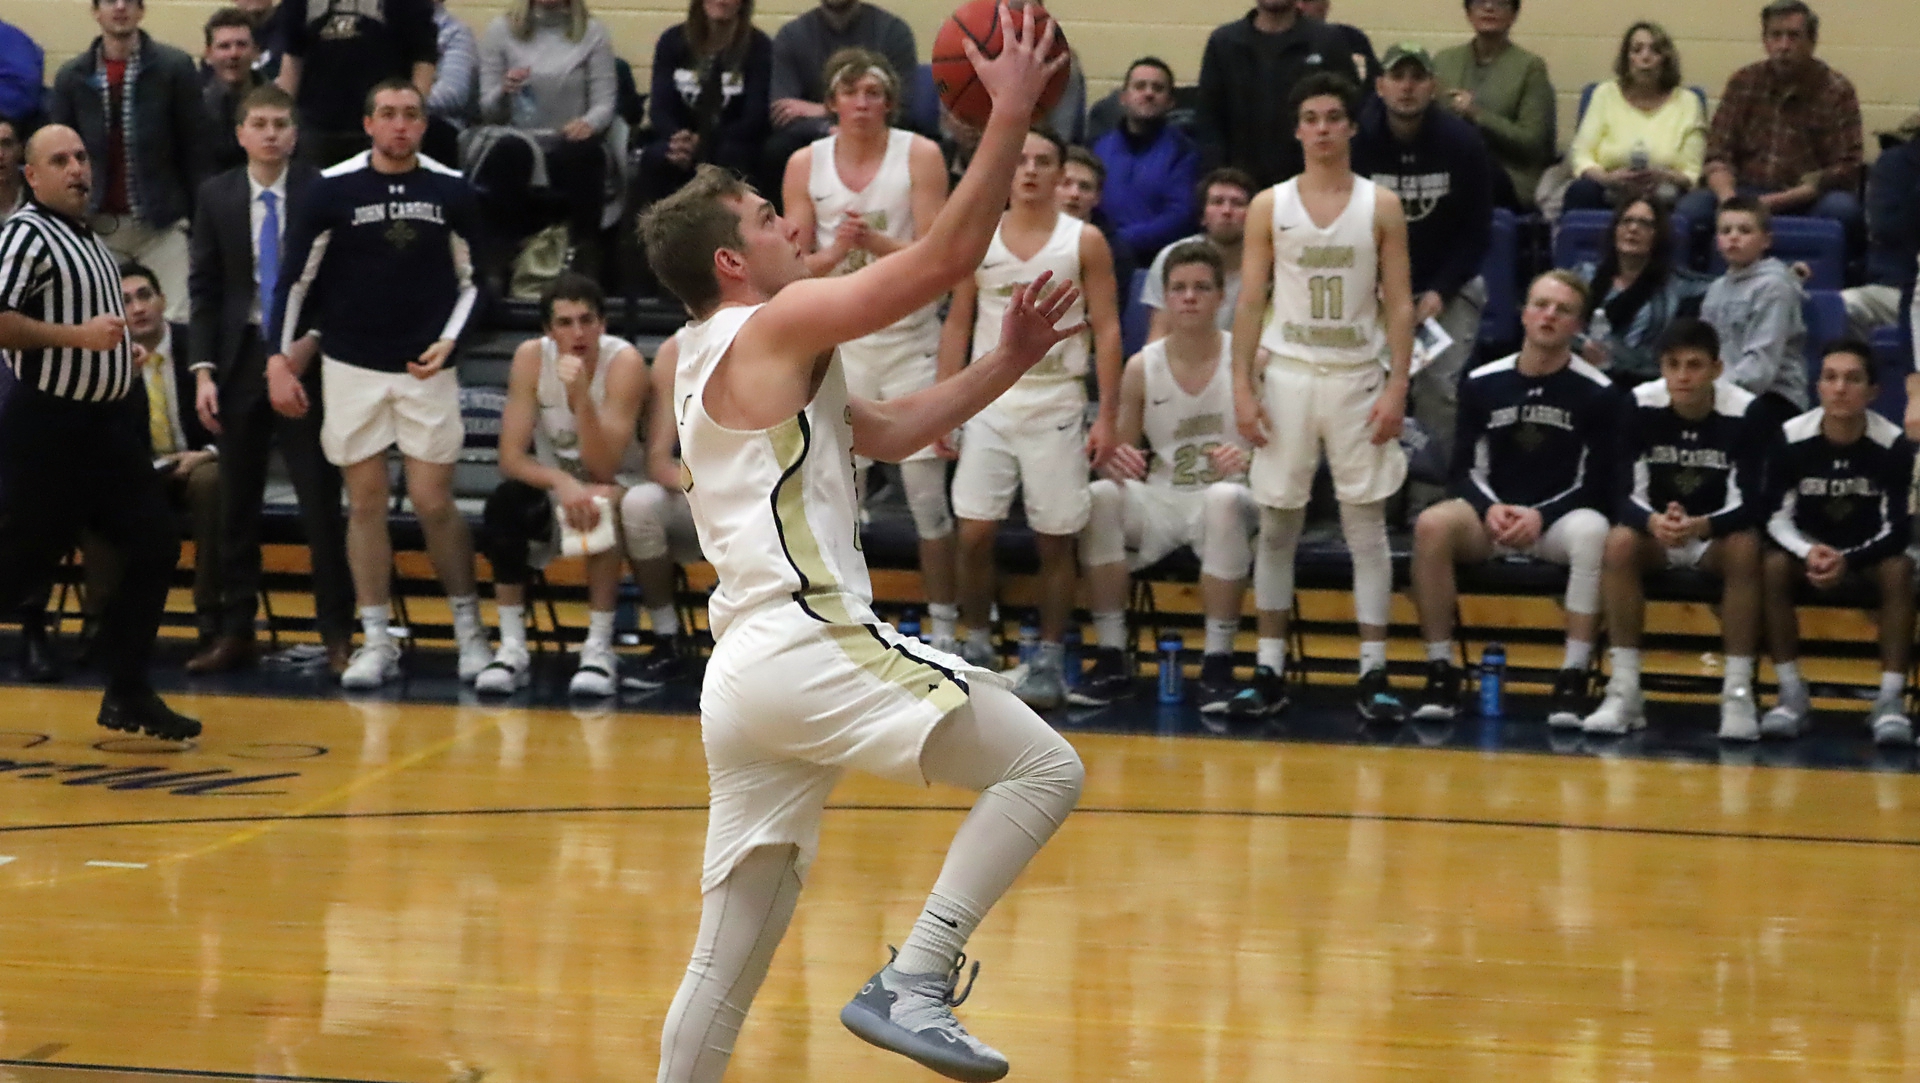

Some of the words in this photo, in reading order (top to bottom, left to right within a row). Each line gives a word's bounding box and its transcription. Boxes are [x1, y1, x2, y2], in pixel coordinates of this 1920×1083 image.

[351, 203, 386, 226] JOHN
[388, 201, 445, 225] CARROLL
[1309, 275, 1343, 320] 11
[1486, 405, 1519, 429] JOHN
[1521, 404, 1574, 432] CARROLL
[1646, 445, 1678, 464] JOHN
[1679, 448, 1729, 469] CARROLL
